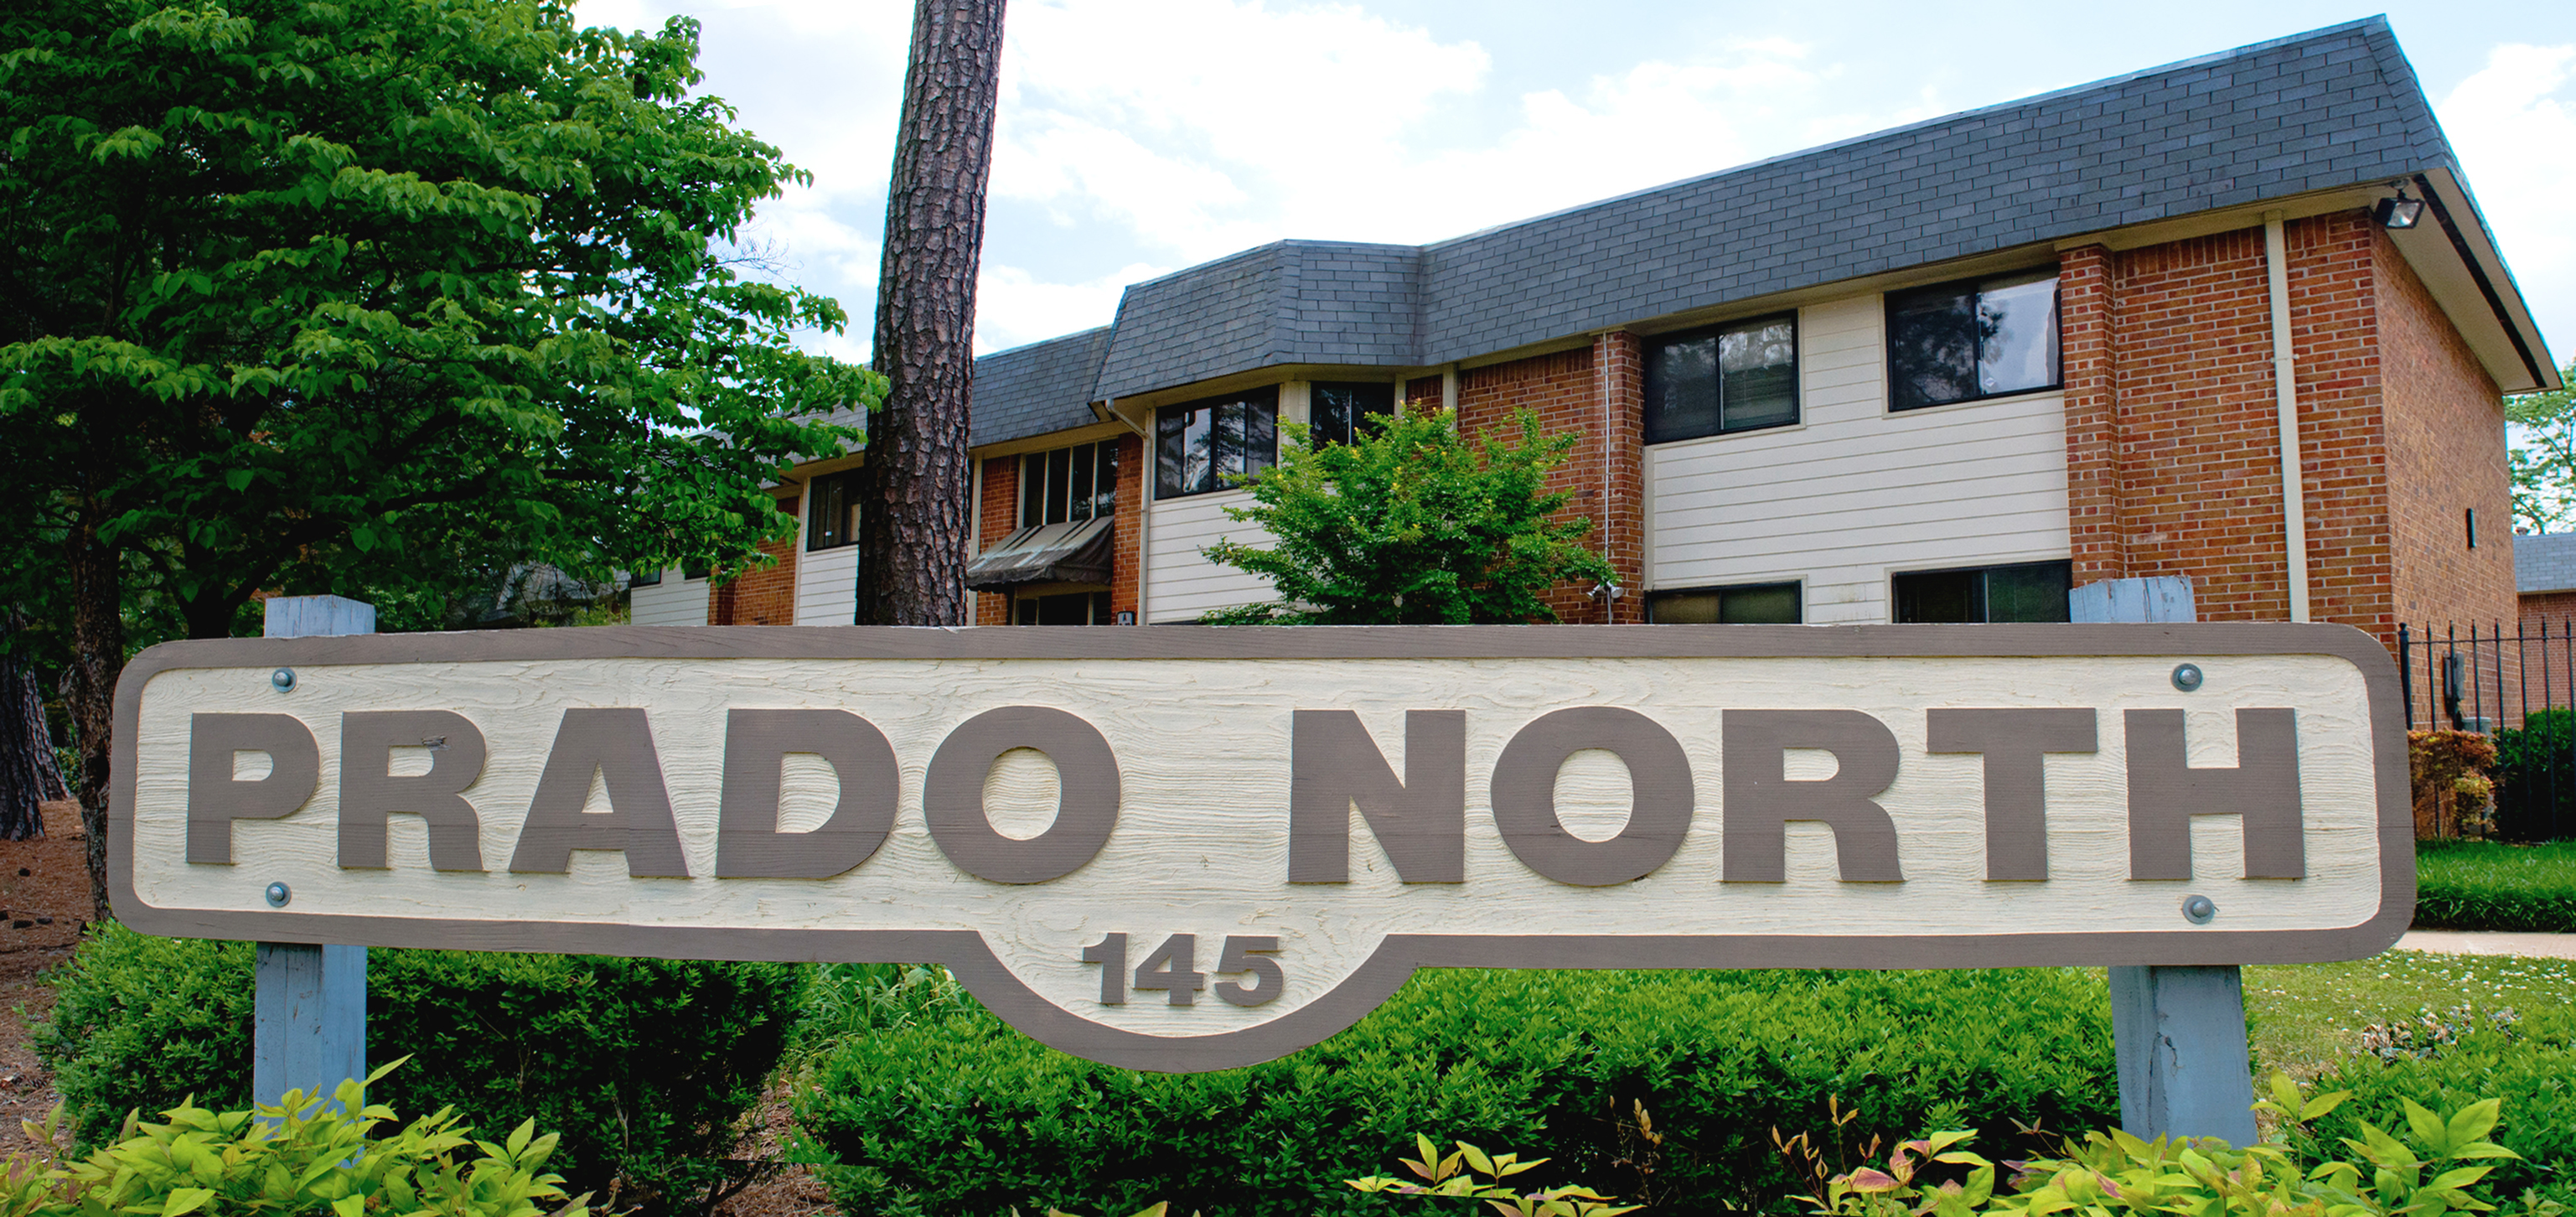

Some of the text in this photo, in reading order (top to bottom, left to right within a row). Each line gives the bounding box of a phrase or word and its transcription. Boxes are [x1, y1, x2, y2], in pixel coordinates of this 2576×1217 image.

[185, 706, 2306, 890] PRADO NORTH
[1081, 932, 1284, 1007] 145
